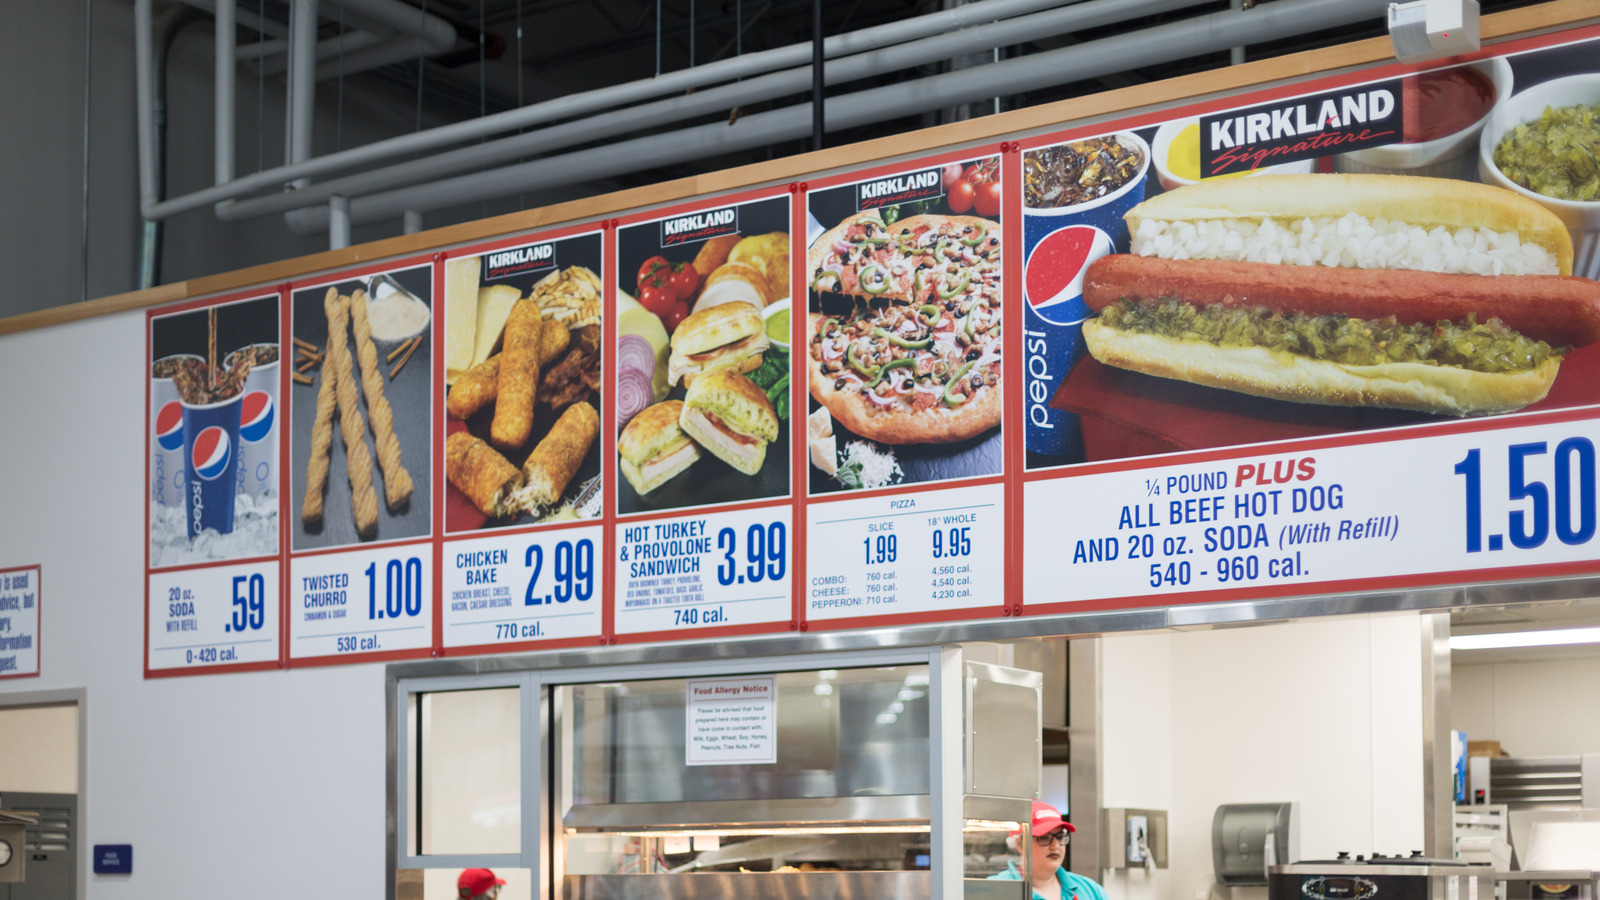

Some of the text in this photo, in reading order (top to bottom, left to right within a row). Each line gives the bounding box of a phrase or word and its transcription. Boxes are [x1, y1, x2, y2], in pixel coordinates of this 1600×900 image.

[1210, 89, 1395, 150] KIRKLAND
[1211, 128, 1395, 175] Signature
[861, 171, 938, 199] KIRKLAND
[862, 189, 938, 209] Signature
[665, 209, 735, 235] KIRKLAND
[665, 227, 734, 245] Signature
[489, 244, 552, 268] KIRKLAND
[489, 261, 552, 278] Signature
[1025, 330, 1054, 428] pepsi
[237, 446, 246, 494] epsi
[1167, 471, 1227, 494] POUND
[1235, 457, 1316, 488] PLUS
[891, 499, 915, 509] PIZZA
[1455, 436, 1596, 553] 1.50
[1118, 484, 1343, 530] ALL BEEF HOT DOG
[868, 522, 894, 532] SLICE
[943, 513, 976, 524] WHOLE
[626, 520, 706, 543] HOT TURKEY
[933, 527, 970, 558] 9.95
[1073, 515, 1399, 564] AND 20 oz. SODA (With Refill)
[457, 549, 507, 568] CHICKEN
[620, 537, 711, 562] & PROVOLONE
[718, 521, 786, 586] 3.99
[864, 534, 897, 564] 1.99
[467, 568, 496, 585] BAKE
[525, 538, 593, 606] 2.99
[631, 557, 699, 578] SANDWICH
[812, 564, 972, 586] COMBO: 760 cal. 4,560 cal.
[1150, 561, 1190, 588] 540
[1217, 555, 1259, 582] 960
[1268, 551, 1309, 578] cal.
[303, 573, 348, 591] TWISTED
[365, 557, 422, 619] 1.00
[812, 576, 972, 597] CHEESE: 760 cal. 4,540 cal.
[169, 587, 194, 601] 20 oz.
[225, 573, 264, 632] .59
[304, 591, 347, 608] CHURRO
[812, 589, 972, 609] PEPPERONI: 710 cal. 4,230 cal.
[169, 602, 194, 617] SODA
[674, 606, 728, 625] 740 cal.
[166, 619, 197, 632] WITH REFILL
[496, 621, 544, 639] 770 cal.
[220, 646, 238, 661] cal.
[338, 634, 380, 651] 530 cal.
